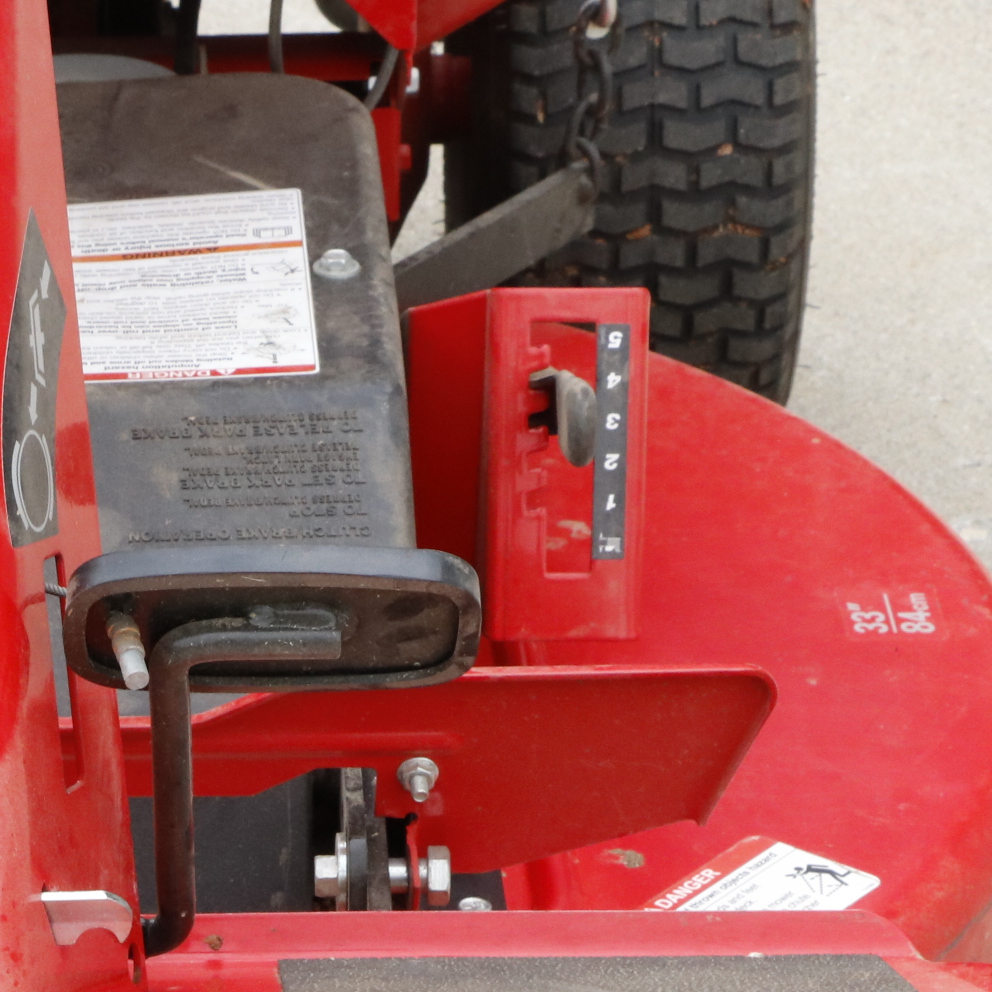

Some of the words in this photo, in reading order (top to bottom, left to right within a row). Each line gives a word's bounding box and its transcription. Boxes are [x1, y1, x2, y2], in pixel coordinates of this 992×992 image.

[122, 248, 203, 260] WARNING
[608, 331, 622, 348] 5
[127, 369, 212, 378] DANGER
[606, 372, 622, 389] 4
[605, 413, 620, 430] 3
[253, 424, 333, 437] RELEASE
[604, 453, 619, 469] 2
[605, 494, 616, 511] 1
[288, 506, 337, 518] STOP
[128, 530, 230, 544] OPERATION
[654, 868, 721, 909] DANGER
